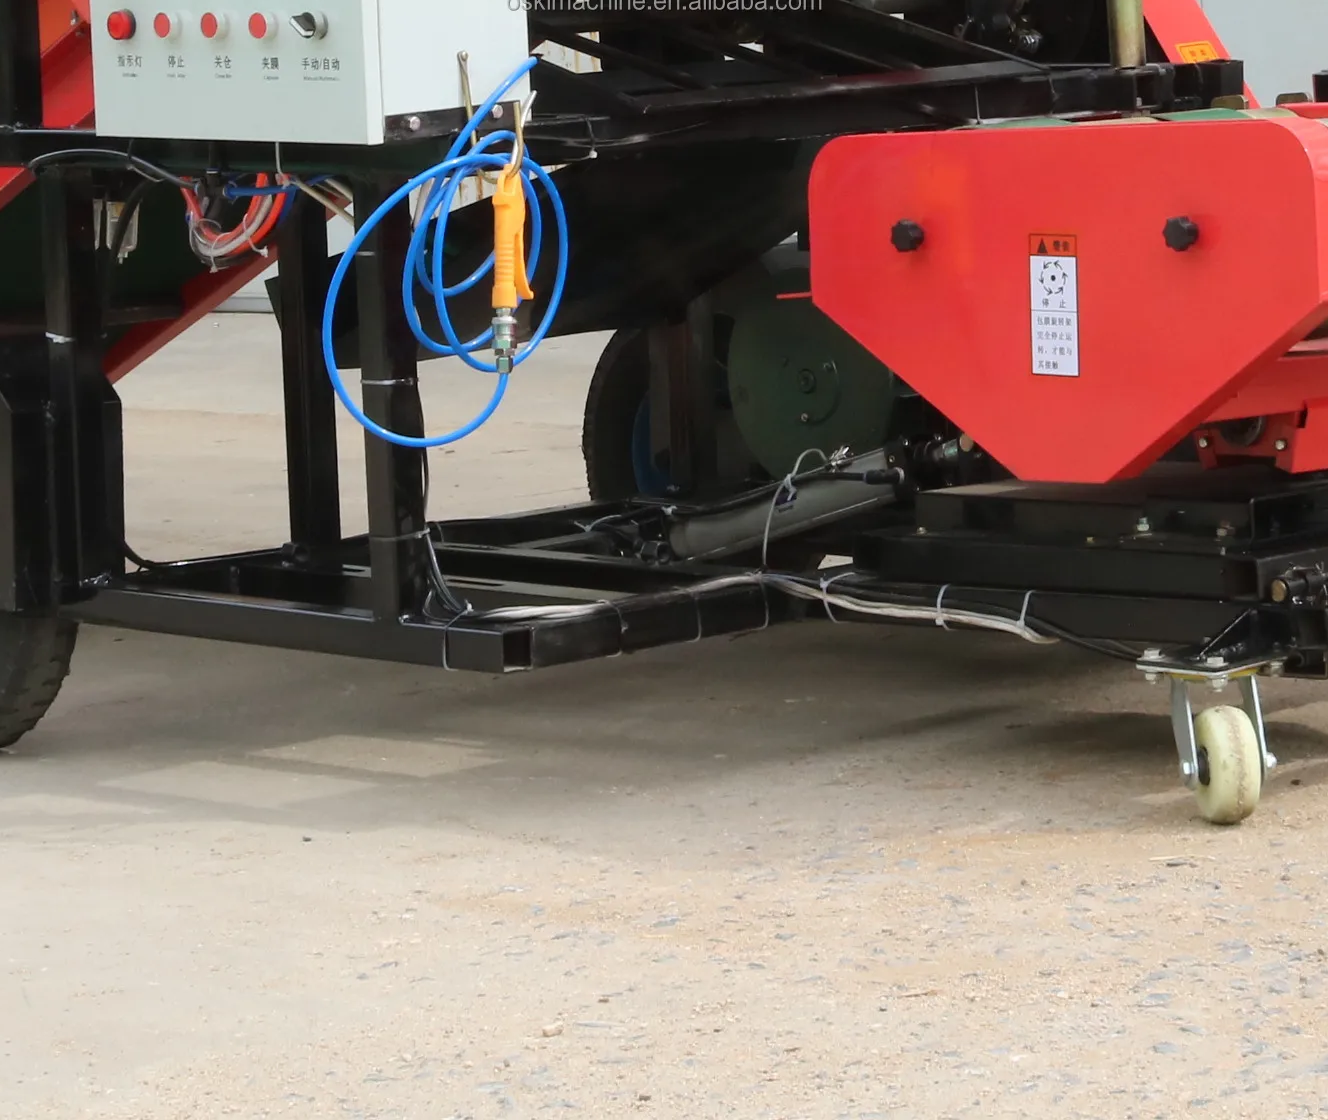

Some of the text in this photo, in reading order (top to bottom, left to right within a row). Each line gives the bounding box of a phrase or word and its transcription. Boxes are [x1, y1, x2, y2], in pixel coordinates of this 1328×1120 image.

[117, 54, 142, 67] 指示灯
[168, 55, 184, 68] 停止
[301, 57, 340, 70] 手动/自动
